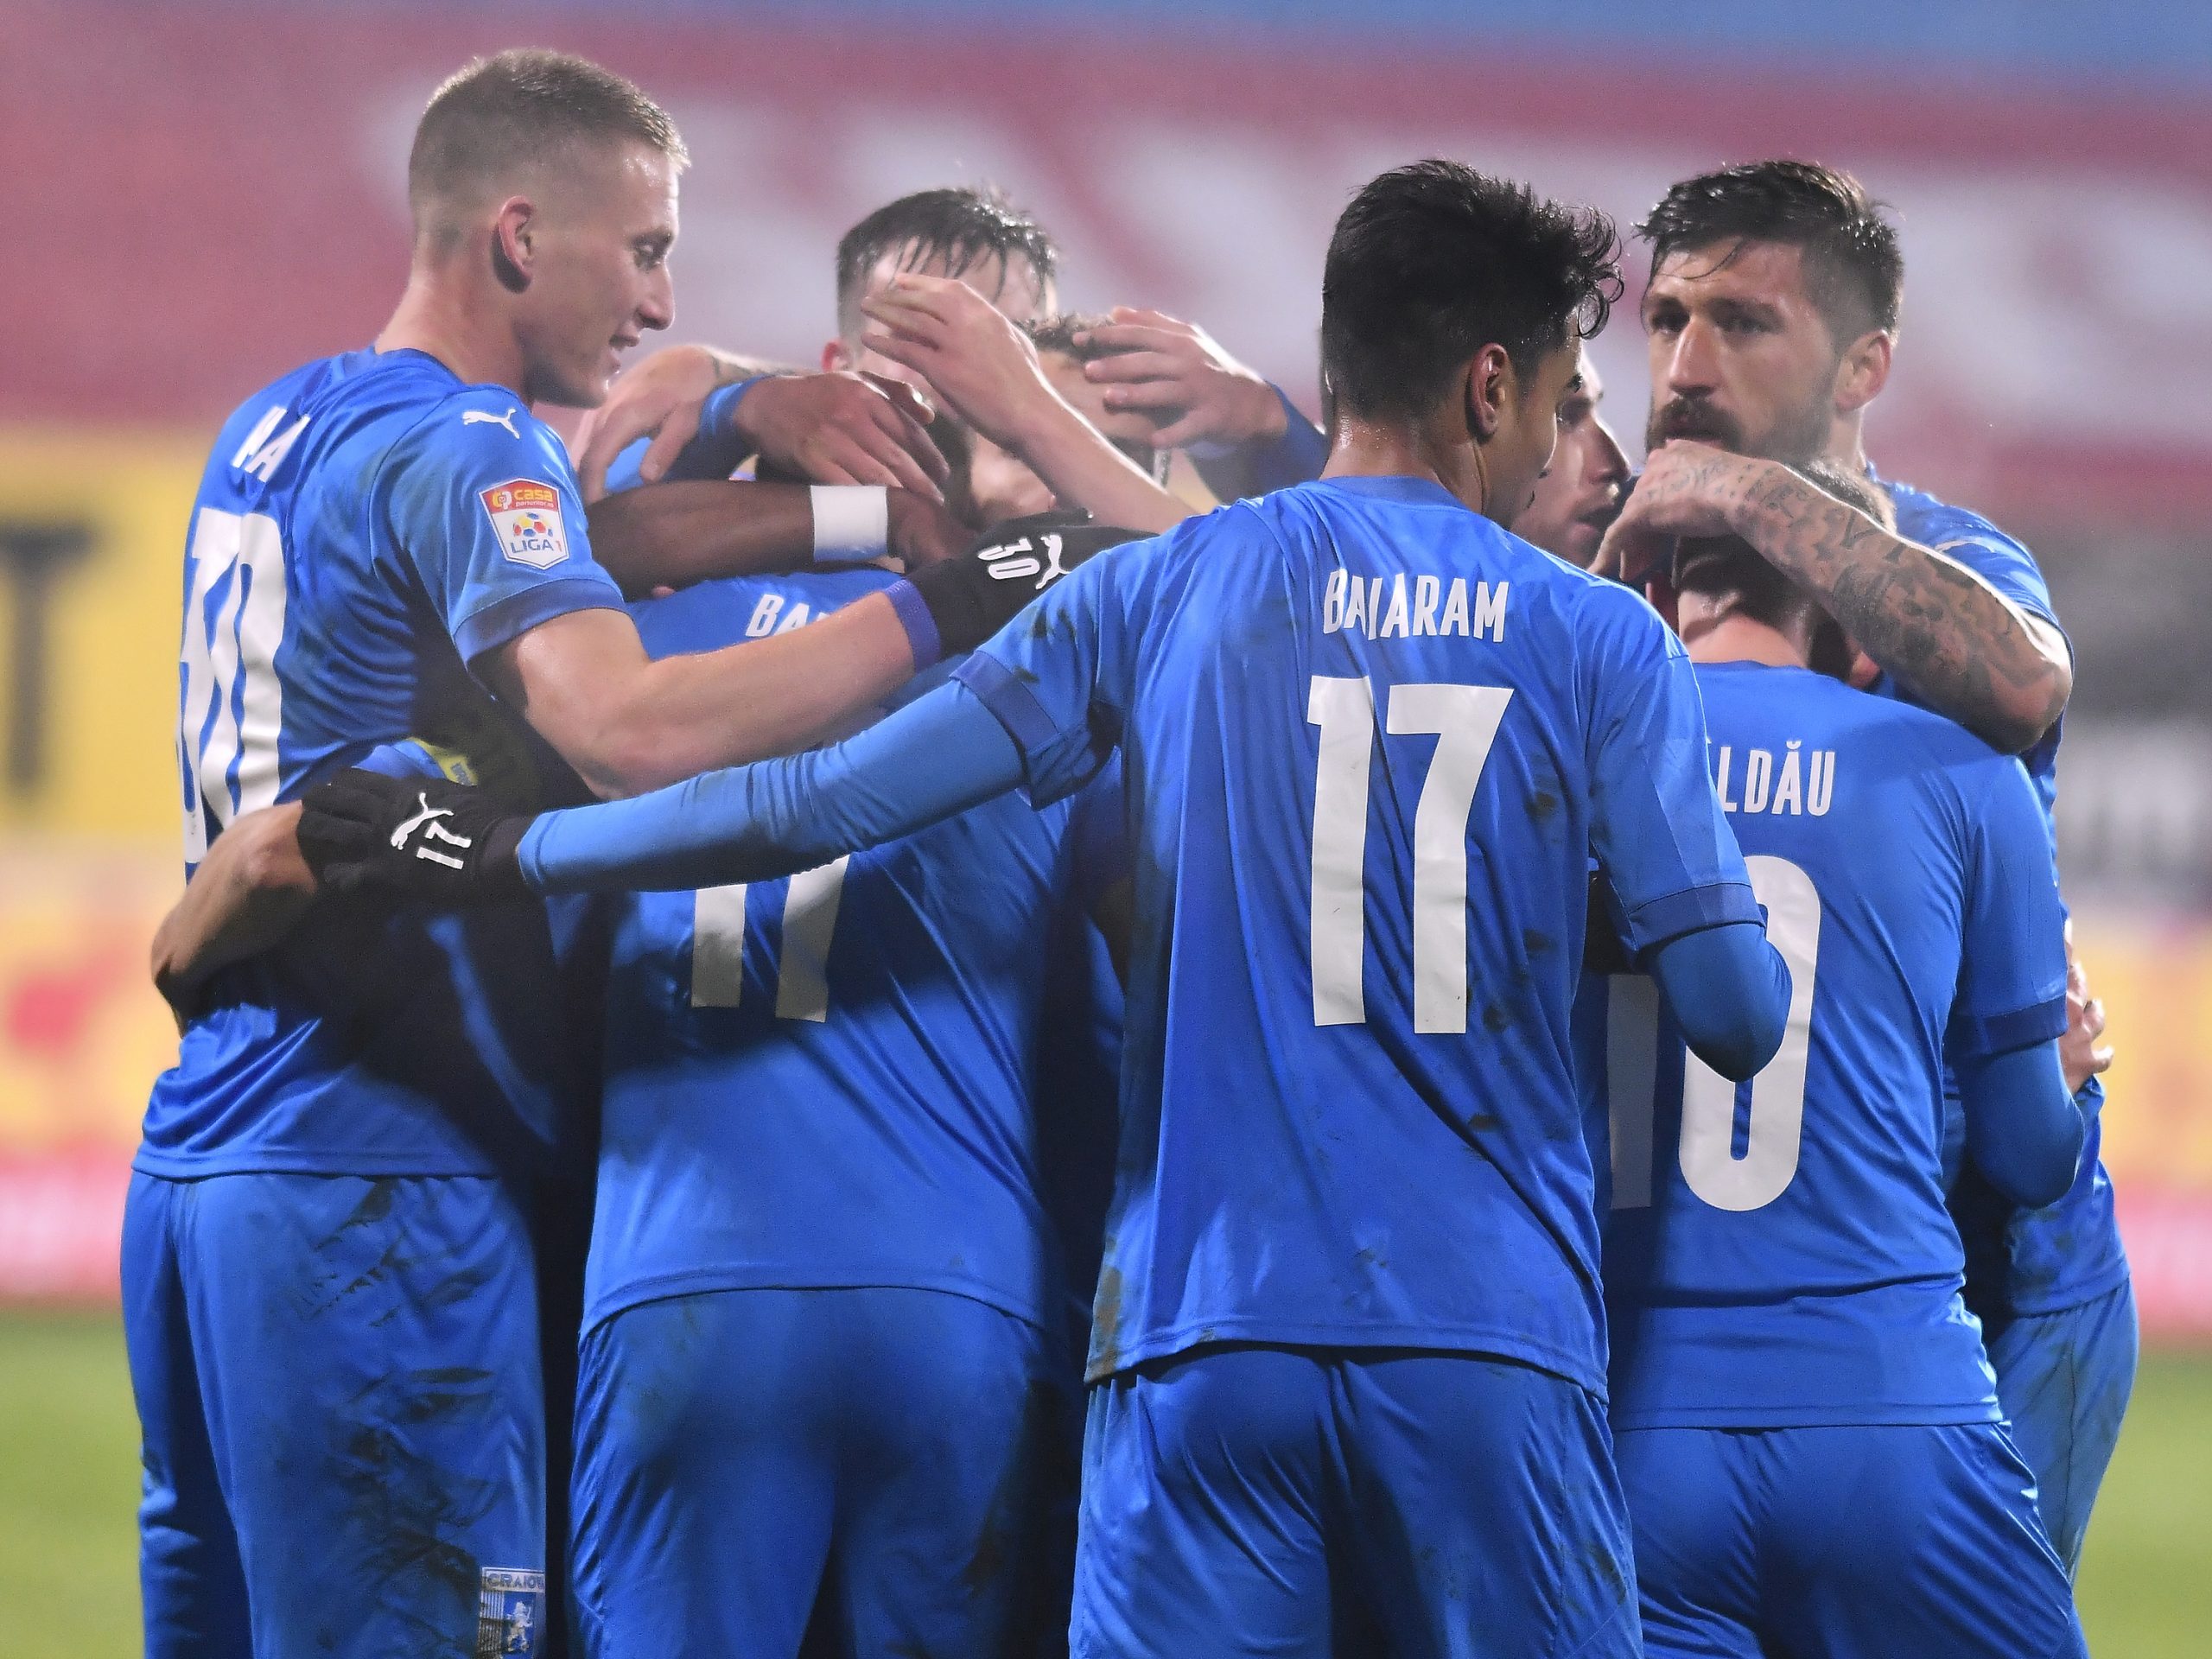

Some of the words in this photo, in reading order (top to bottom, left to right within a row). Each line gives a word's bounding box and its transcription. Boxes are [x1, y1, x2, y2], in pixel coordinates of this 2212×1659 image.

[511, 538, 555, 554] LIGA
[977, 537, 1040, 580] 30
[1323, 567, 1510, 643] BAIARAM
[1706, 738, 1835, 817] LDĂU
[416, 821, 472, 869] 17
[1306, 675, 1514, 1034] 17
